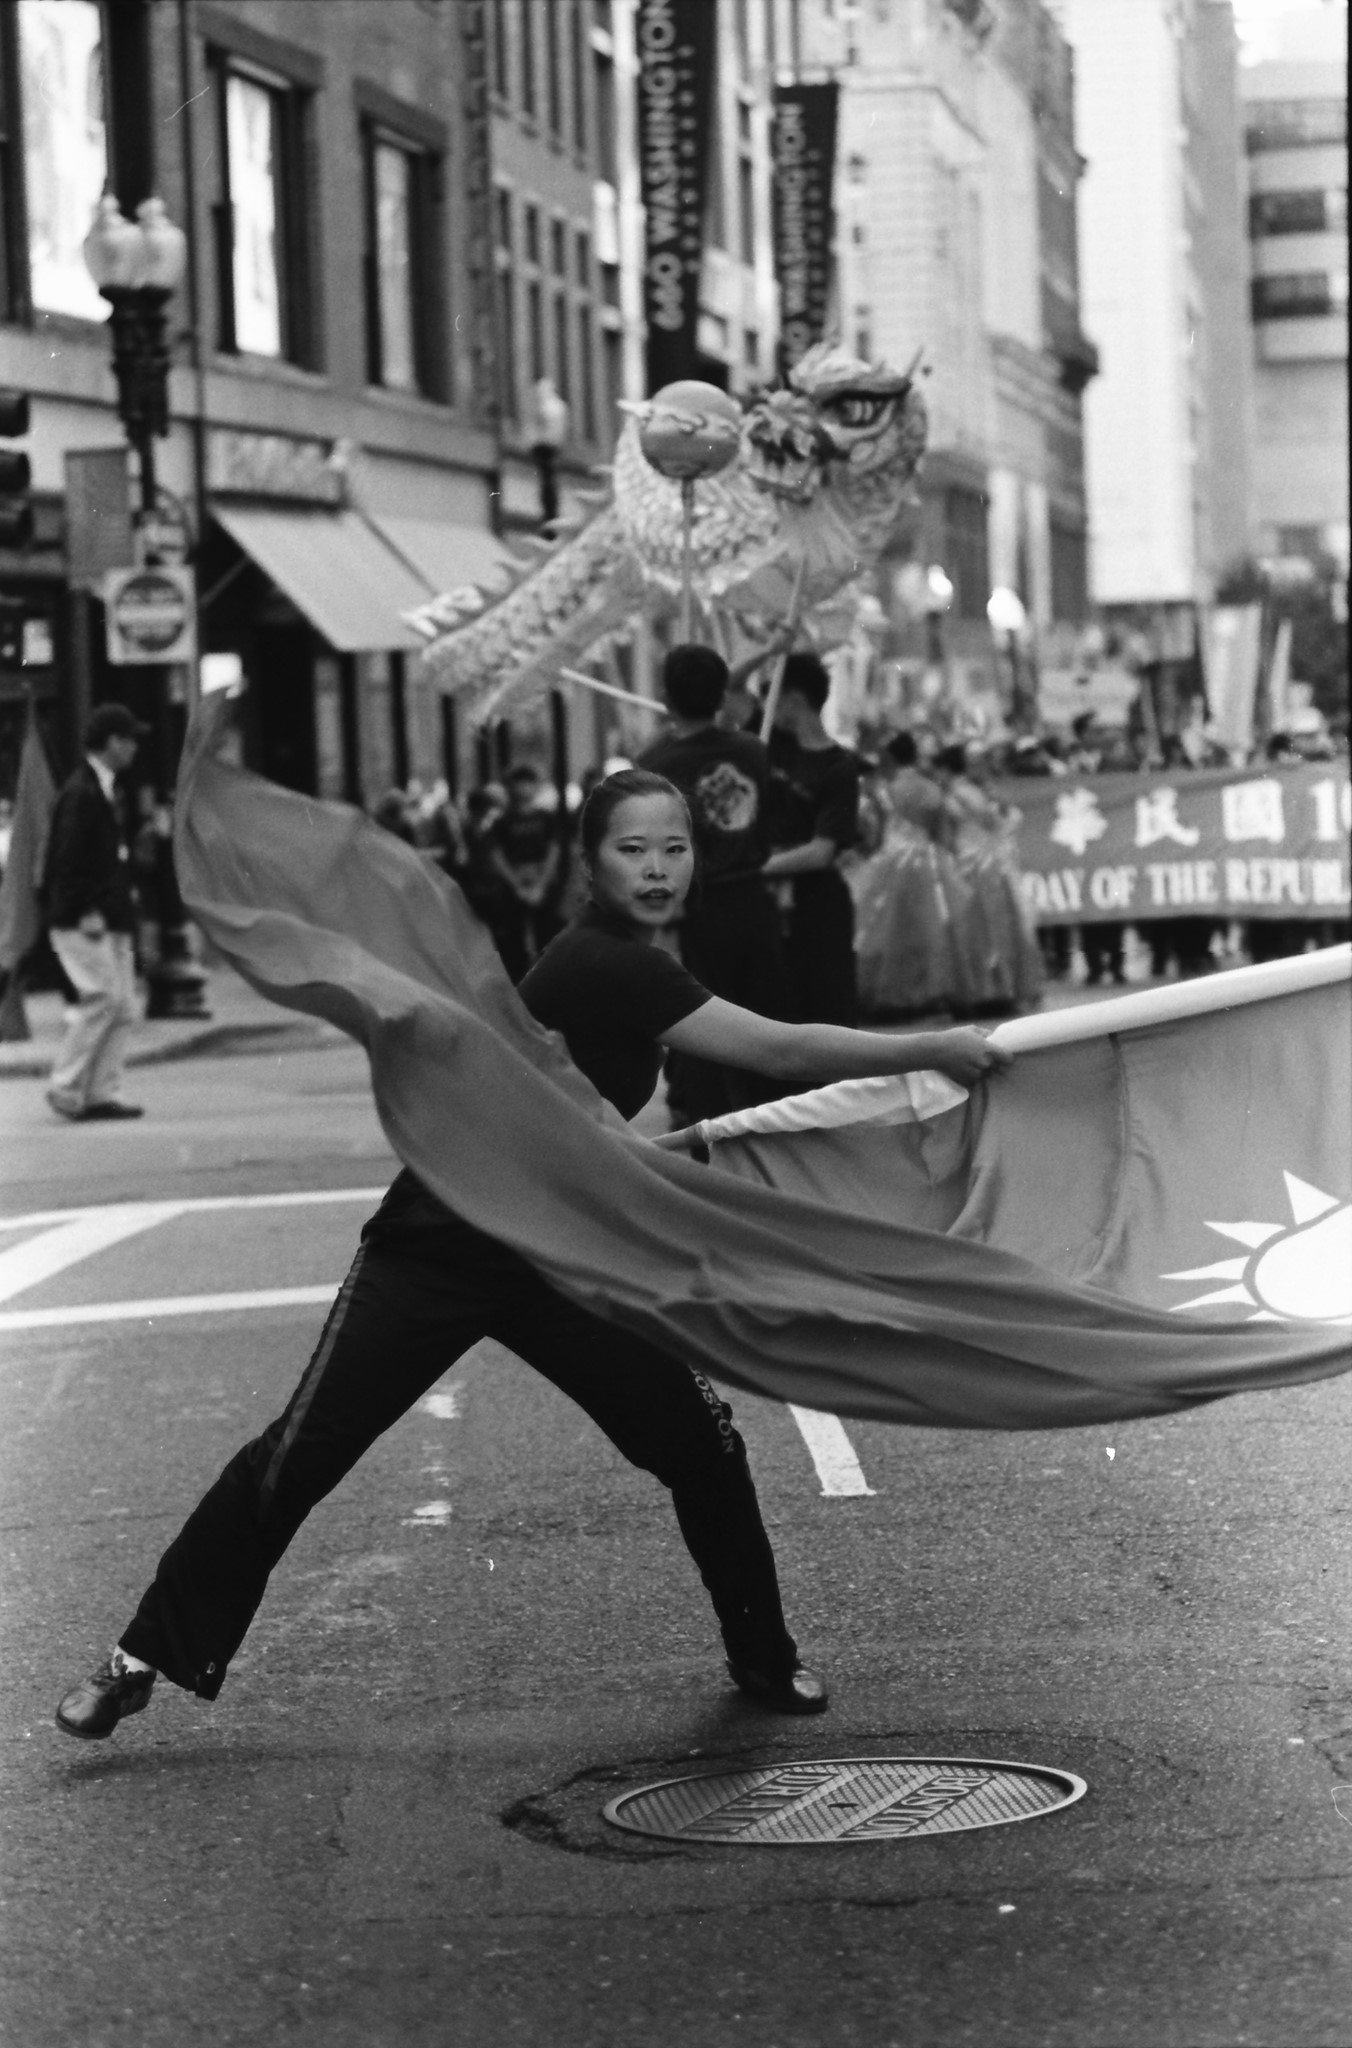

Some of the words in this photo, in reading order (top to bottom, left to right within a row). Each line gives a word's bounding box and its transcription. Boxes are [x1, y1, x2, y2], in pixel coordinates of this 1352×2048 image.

[641, 0, 679, 246] WASHINGTON
[1091, 865, 1137, 910] OF
[1146, 860, 1219, 906] THE
[846, 1776, 992, 1837] BOSTON
